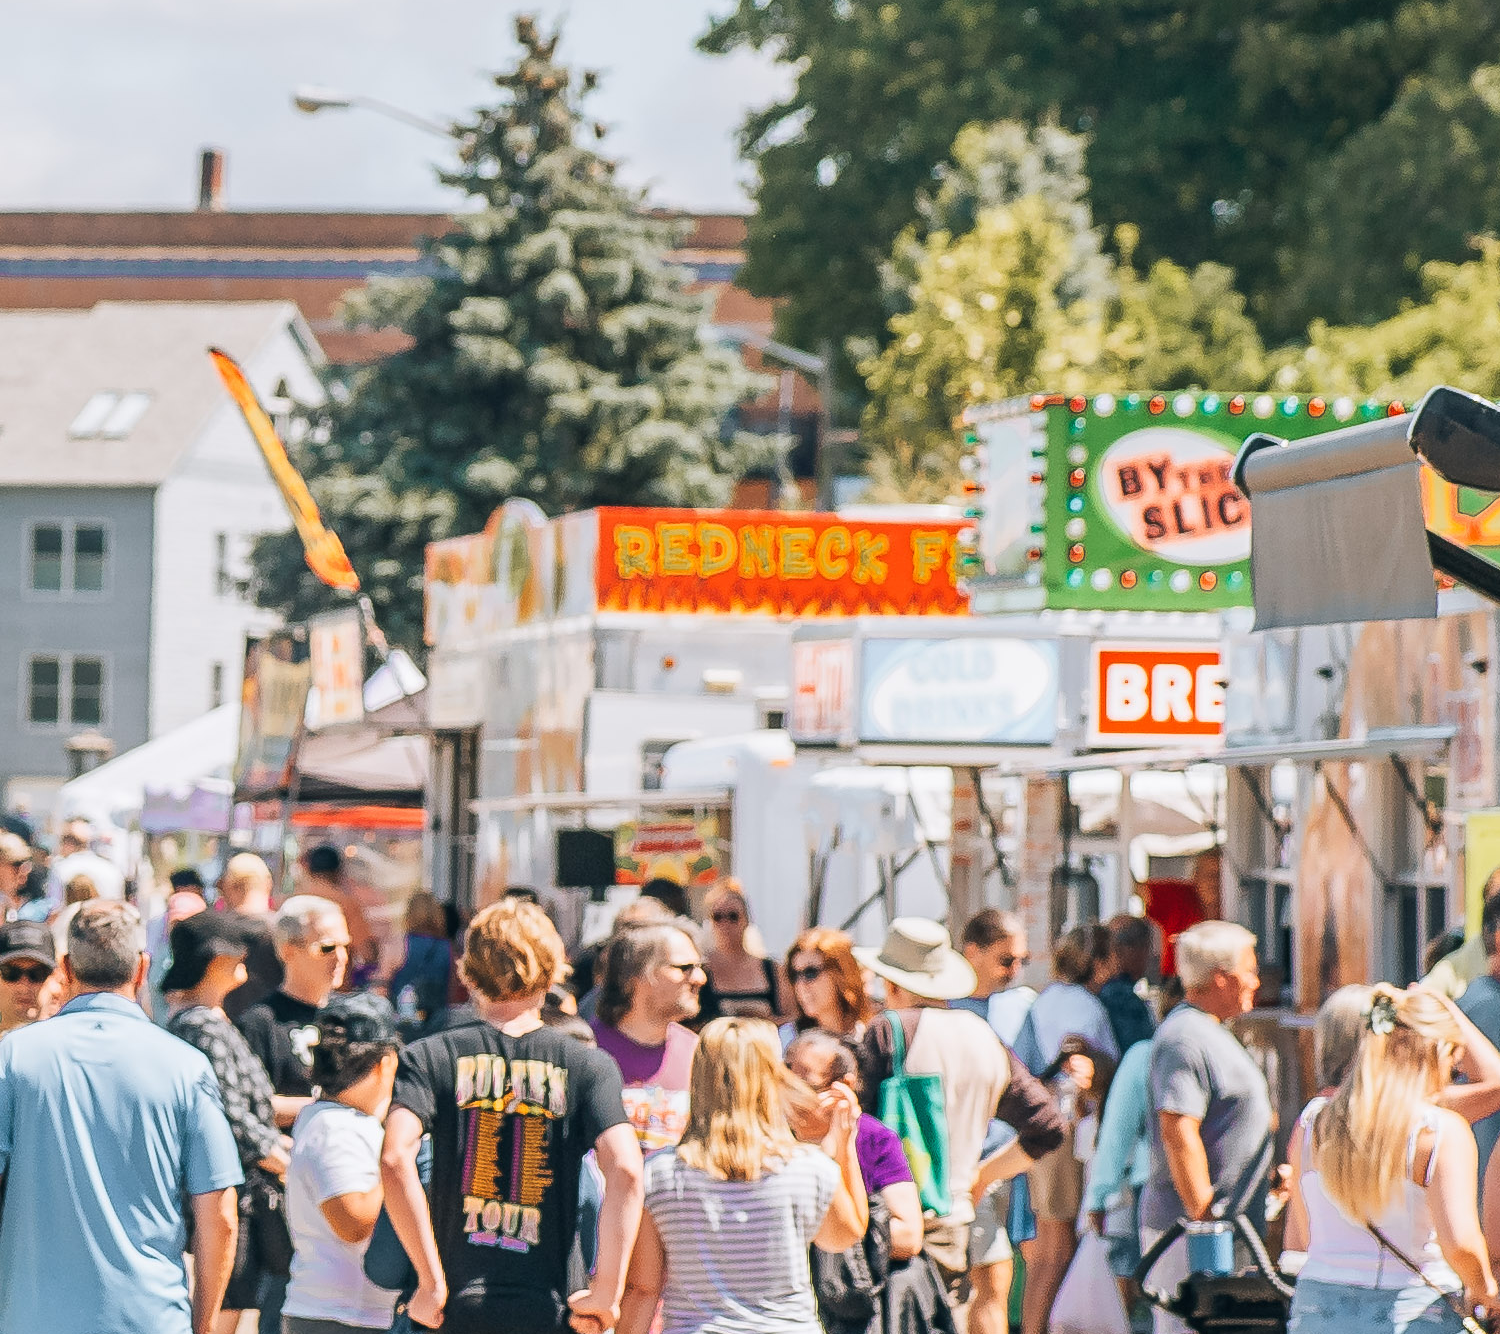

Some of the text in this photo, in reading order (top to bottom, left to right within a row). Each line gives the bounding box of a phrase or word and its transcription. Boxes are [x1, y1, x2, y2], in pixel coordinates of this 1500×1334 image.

[1117, 456, 1170, 496] BY
[1143, 493, 1246, 540] SLIC
[613, 523, 890, 584] REDNECK
[1105, 662, 1226, 724] BRE
[463, 1195, 541, 1245] TOUR
